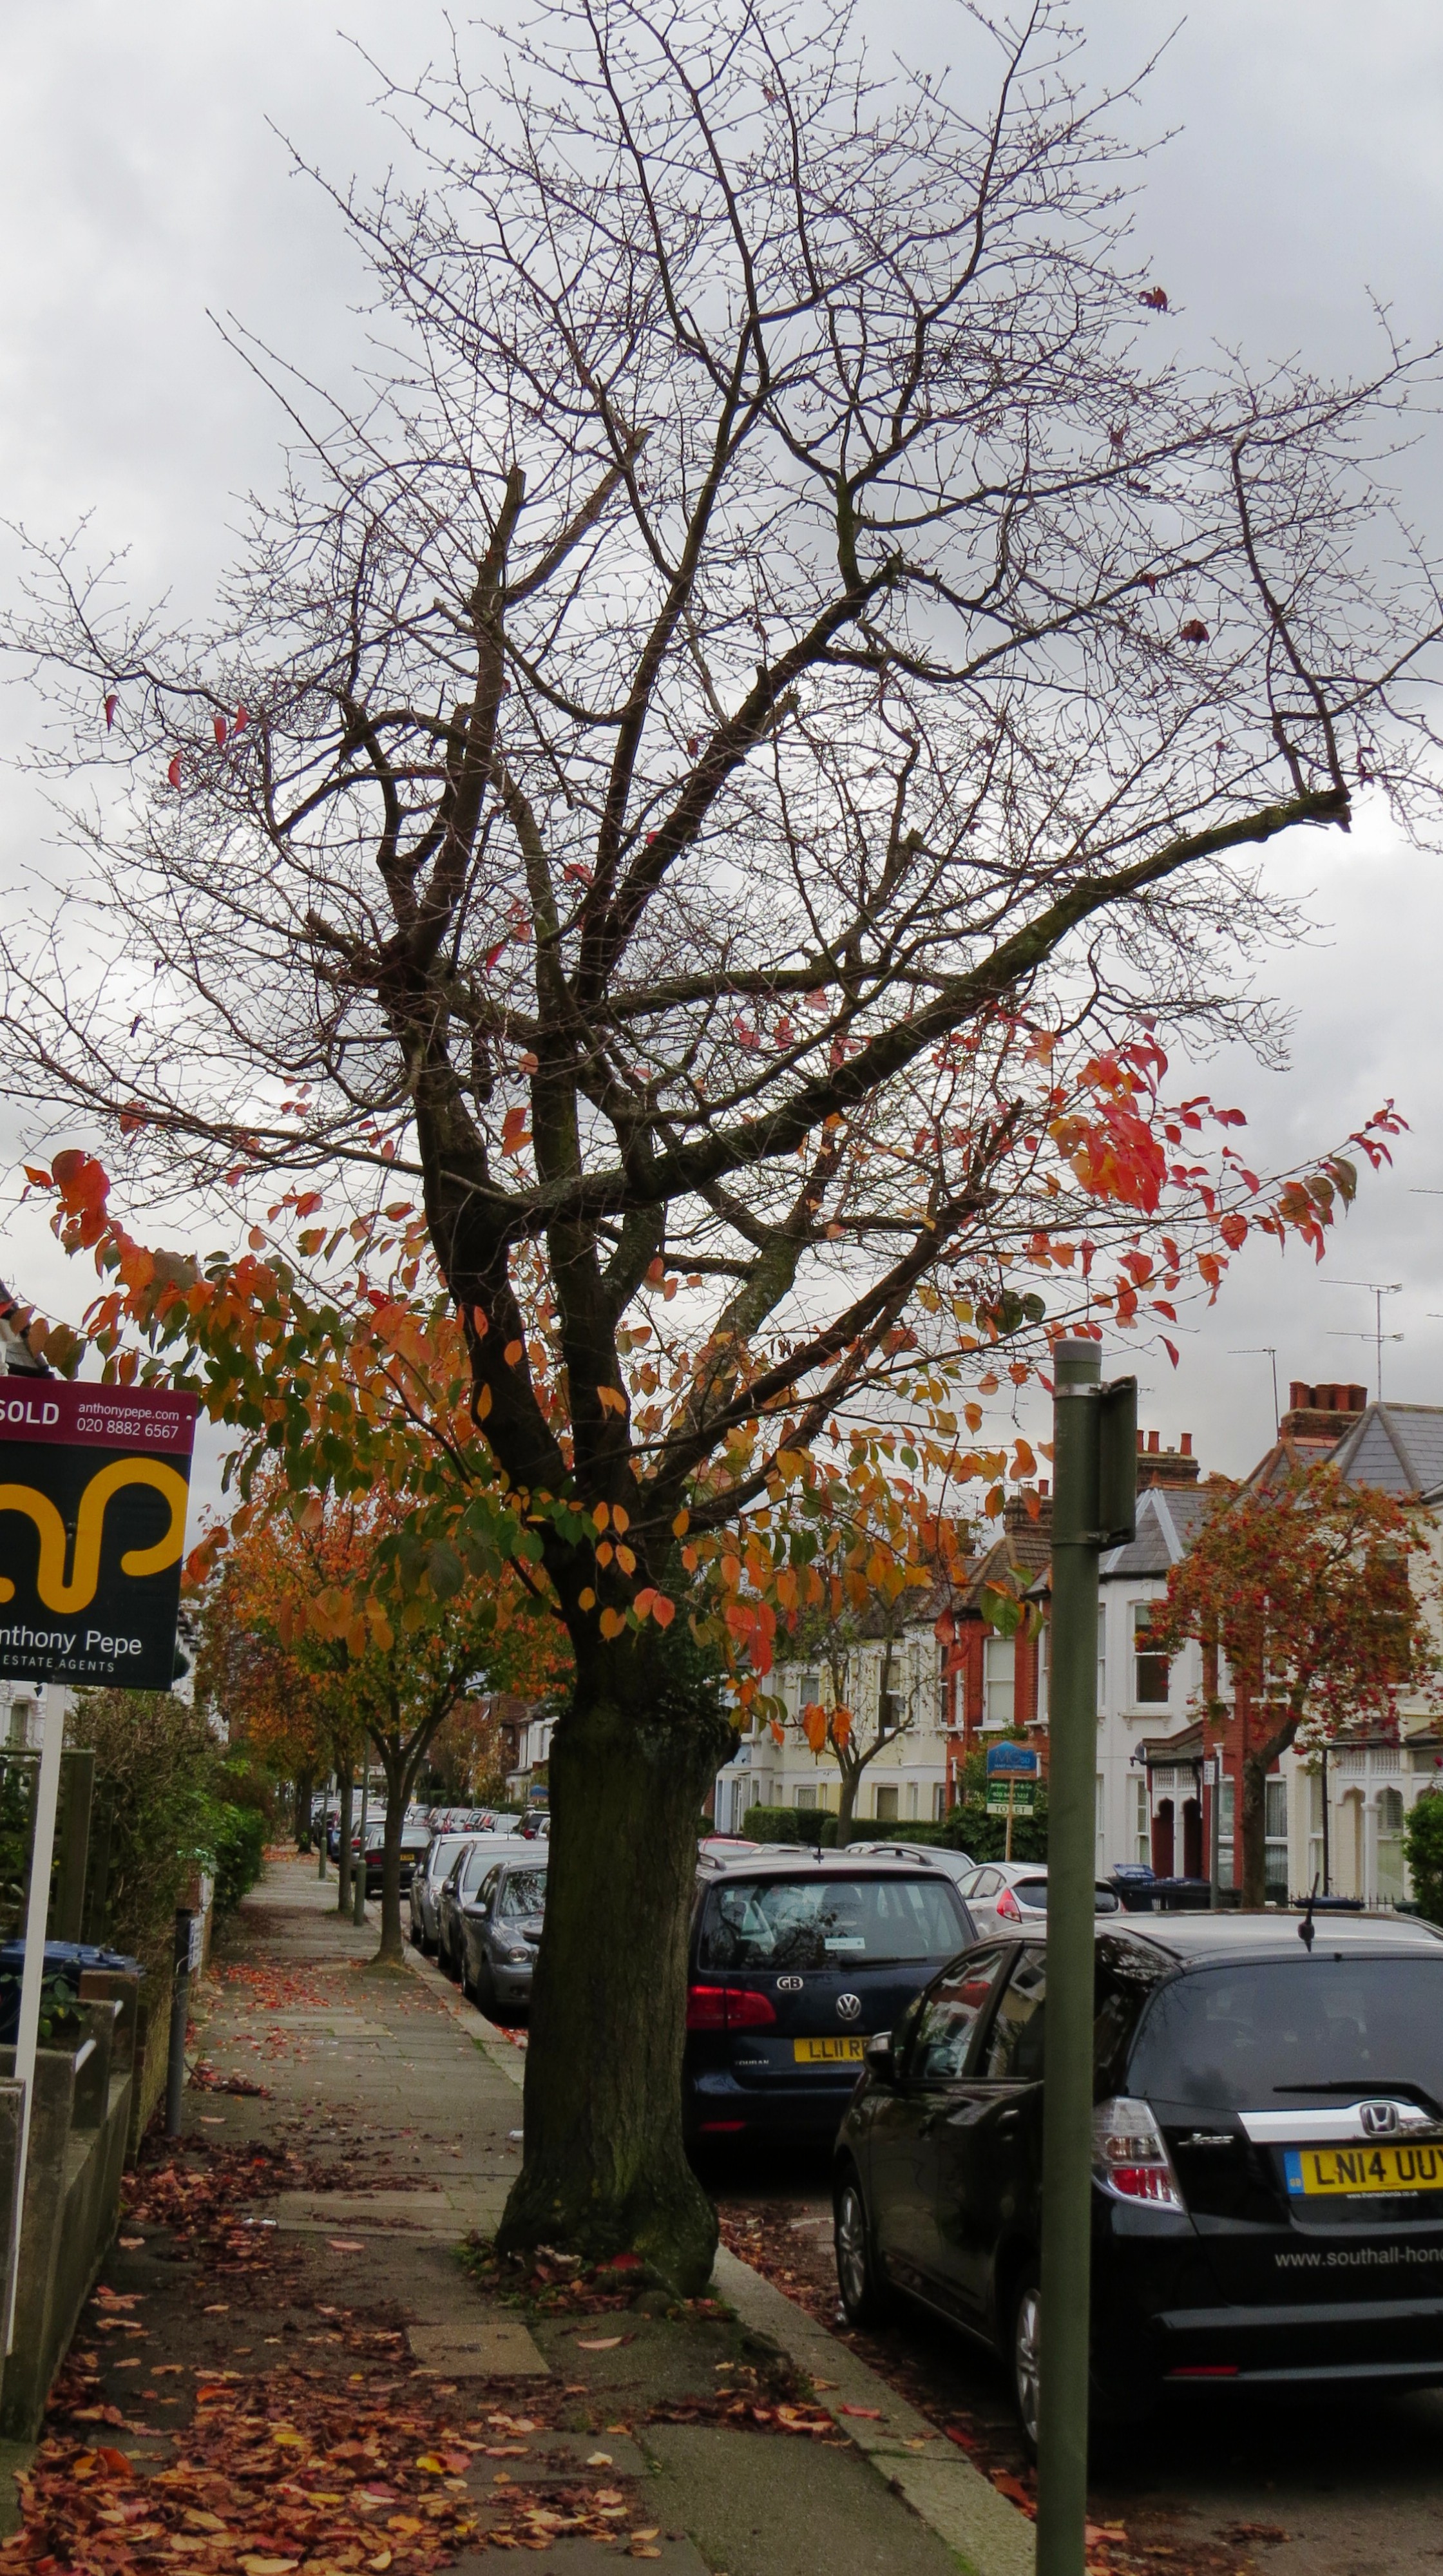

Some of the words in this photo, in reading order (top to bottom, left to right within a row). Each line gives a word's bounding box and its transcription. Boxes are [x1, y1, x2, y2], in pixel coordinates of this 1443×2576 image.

[79, 1402, 179, 1420] anthonypepe.com
[77, 1417, 103, 1433] 020
[106, 1420, 140, 1436] 8882
[145, 1424, 178, 1439] 6567
[86, 1630, 142, 1658] Pepe
[3, 1655, 53, 1667] ESTATE
[59, 1659, 114, 1673] AGENTS
[778, 1977, 801, 1989] GB
[1314, 2151, 1386, 2185] LN14
